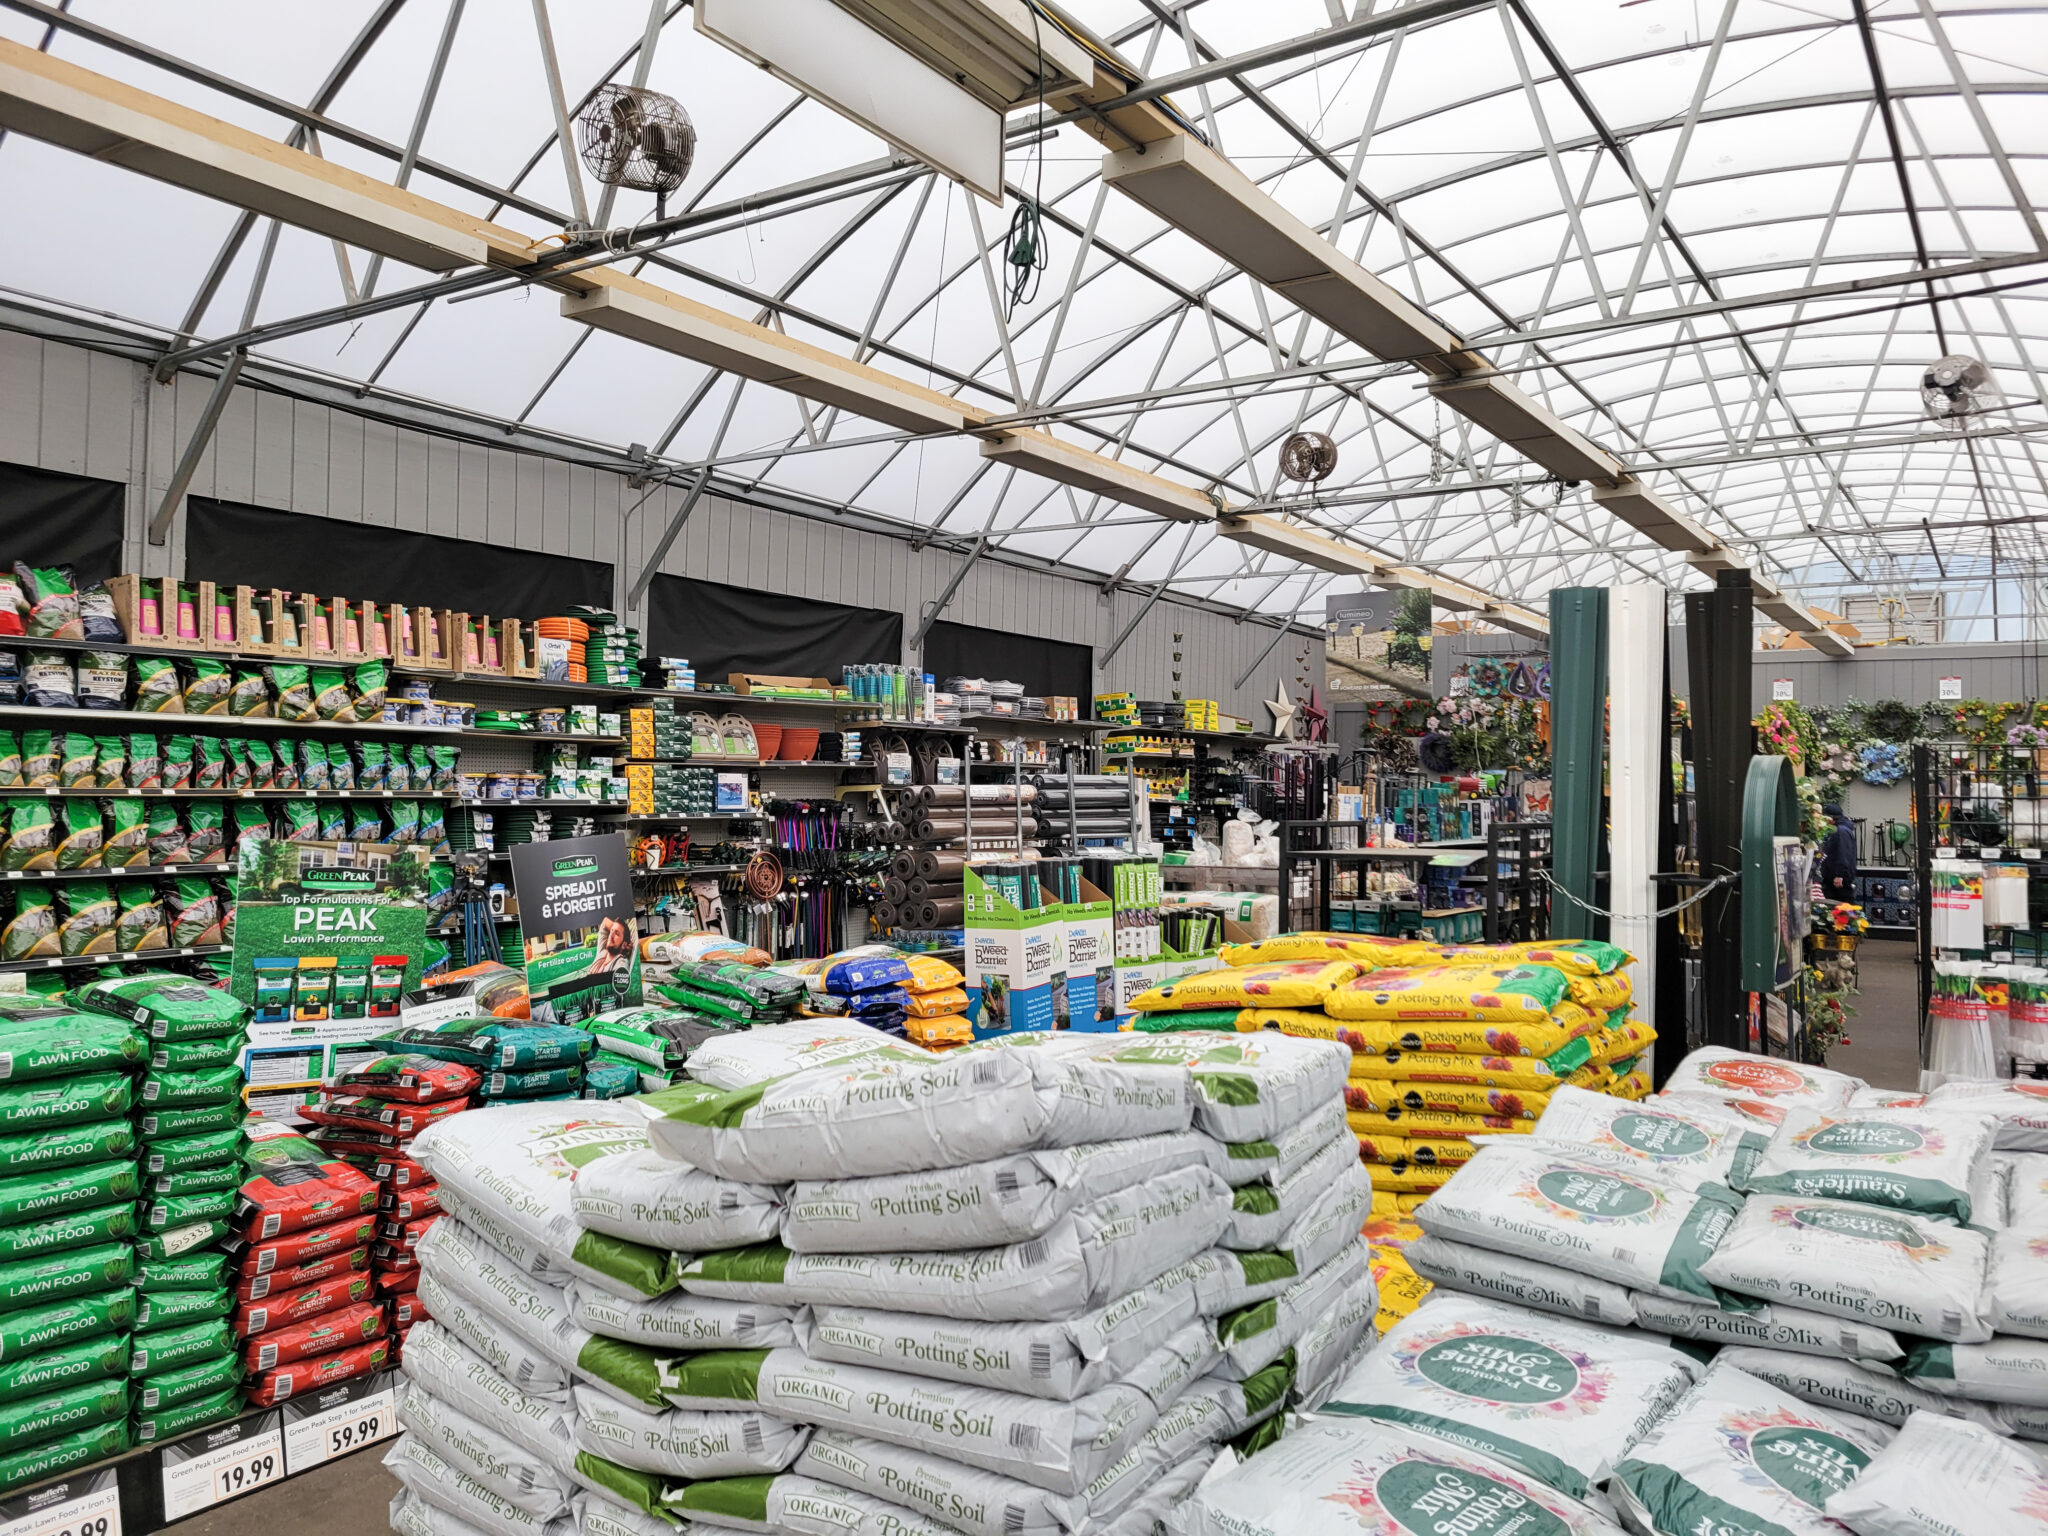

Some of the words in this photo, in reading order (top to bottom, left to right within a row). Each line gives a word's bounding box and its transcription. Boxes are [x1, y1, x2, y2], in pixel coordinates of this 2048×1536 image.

[545, 881, 596, 901] SPREAD
[596, 878, 608, 892] IT
[281, 894, 296, 906] Top
[303, 894, 372, 905] Formulations
[375, 896, 392, 905] For
[542, 905, 552, 918] &
[554, 898, 604, 917] FORGET
[294, 907, 378, 931] PEAK
[284, 934, 314, 944] Lawn
[318, 934, 385, 943] Performance
[1069, 937, 1098, 948] Weed
[538, 957, 566, 969] Fertilize
[567, 956, 578, 966] and
[580, 951, 594, 962] Chill.
[975, 949, 1008, 965] Barrier
[976, 945, 1008, 956] Weed
[1026, 943, 1052, 958] Weed
[1069, 944, 1097, 963] Barrier
[1026, 952, 1051, 972] Barrier
[1179, 985, 1216, 996] Potting
[1218, 984, 1238, 994] Mix
[433, 1006, 442, 1016] Step
[455, 1002, 474, 1011] Seeding
[374, 1024, 393, 1032] Program
[29, 1054, 69, 1068] LAWN
[72, 1048, 109, 1062] FOOD
[534, 1046, 562, 1056] STARTER
[706, 1055, 750, 1076] ORGANIC
[524, 1074, 550, 1083] STARTER
[842, 1074, 914, 1107] Potting
[916, 1067, 960, 1092] Soil
[1425, 1090, 1464, 1104] Potting
[1466, 1094, 1486, 1104] Mix
[166, 1118, 194, 1128] LAWN
[196, 1113, 224, 1124] FOOD
[10, 1150, 52, 1164] LAWN
[56, 1142, 94, 1156] FOOD
[432, 1138, 467, 1168] ORGANIC
[475, 1164, 515, 1204] Potting
[516, 1196, 550, 1219] Soil
[870, 1194, 942, 1218] Potting
[946, 1184, 982, 1211] Soil
[302, 1206, 344, 1222] WINTERIZER
[576, 1198, 618, 1217] ORGANIC
[799, 1205, 854, 1219] ORGANIC
[468, 1205, 504, 1244] Potting
[504, 1236, 526, 1262] Soil
[1489, 1216, 1547, 1242] Potting
[1551, 1231, 1592, 1252] Mix
[298, 1238, 341, 1254] WINTERIZER
[805, 1256, 869, 1271] ORGANIC
[10, 1281, 50, 1298] LAWN
[54, 1272, 92, 1288] FOOD
[154, 1271, 182, 1282] LAWN
[184, 1272, 209, 1281] FOOD
[1500, 1272, 1534, 1285] Premium
[479, 1262, 524, 1307] Potting
[521, 1296, 555, 1322] Soil
[1464, 1270, 1524, 1299] Potting
[1528, 1288, 1572, 1309] Mix
[1834, 1280, 1876, 1298] Premium
[1789, 1280, 1865, 1313] Potting
[1869, 1299, 1924, 1326] Mix
[636, 1312, 692, 1338] Potting
[694, 1315, 721, 1340] Soil
[300, 1332, 344, 1350] WINTERIZER
[932, 1330, 972, 1345] Premium
[895, 1336, 968, 1369] Potting
[973, 1348, 1010, 1372] Soil
[1464, 1342, 1552, 1368] Mix
[314, 1364, 354, 1382] WINTERIZER
[1430, 1348, 1562, 1394] Potting
[1450, 1365, 1522, 1390] Premium
[781, 1380, 845, 1404] ORGANIC
[911, 1387, 955, 1406] Premium
[1798, 1376, 1876, 1410] Potting
[164, 1415, 193, 1430] LAWN
[196, 1406, 222, 1422] FOOD
[289, 1426, 310, 1438] Green
[311, 1419, 327, 1432] Peak
[328, 1413, 343, 1424] Step
[349, 1406, 359, 1416] for
[360, 1399, 384, 1412] Seeding
[866, 1392, 946, 1429] Potting
[951, 1408, 994, 1438] Soil
[332, 1416, 380, 1452] 59.99
[1438, 1430, 1474, 1446] KISSEL
[442, 1426, 486, 1468] Potting
[486, 1456, 510, 1481] Soil
[1474, 1441, 1496, 1452] OF
[7, 1460, 48, 1482] LAWN
[51, 1448, 88, 1467] FOOD
[172, 1466, 194, 1480] Green
[195, 1460, 212, 1474] Peak
[214, 1452, 231, 1464] Lawn
[232, 1446, 249, 1457] Food
[256, 1438, 270, 1448] Iron
[271, 1434, 280, 1444] S3
[221, 1455, 274, 1493] 19.99
[878, 1466, 947, 1512] Potting
[948, 1498, 985, 1524] Soil
[14, 1524, 33, 1536] Peak
[35, 1516, 57, 1528] Lawn
[58, 1507, 79, 1520] Food
[88, 1500, 104, 1510] Iron
[106, 1494, 116, 1504] S3
[790, 1500, 856, 1526] ORGANIC
